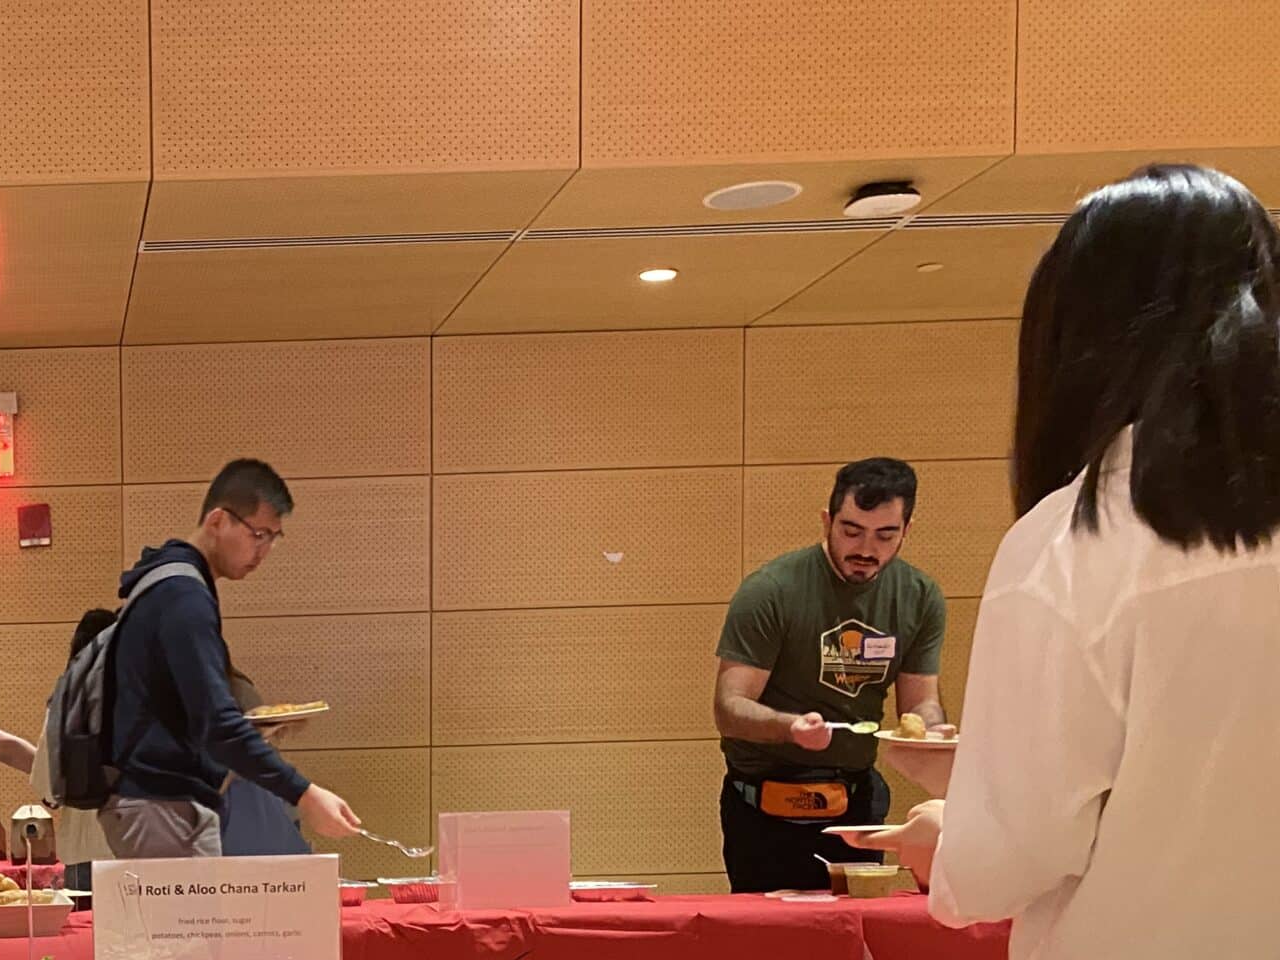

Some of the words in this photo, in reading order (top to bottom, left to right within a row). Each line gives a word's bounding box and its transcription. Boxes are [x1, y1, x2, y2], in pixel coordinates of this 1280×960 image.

[145, 884, 171, 896] Roti
[174, 884, 185, 895] &
[188, 883, 217, 895] Aloo
[220, 882, 259, 894] Chana
[261, 881, 306, 893] Tarkari
